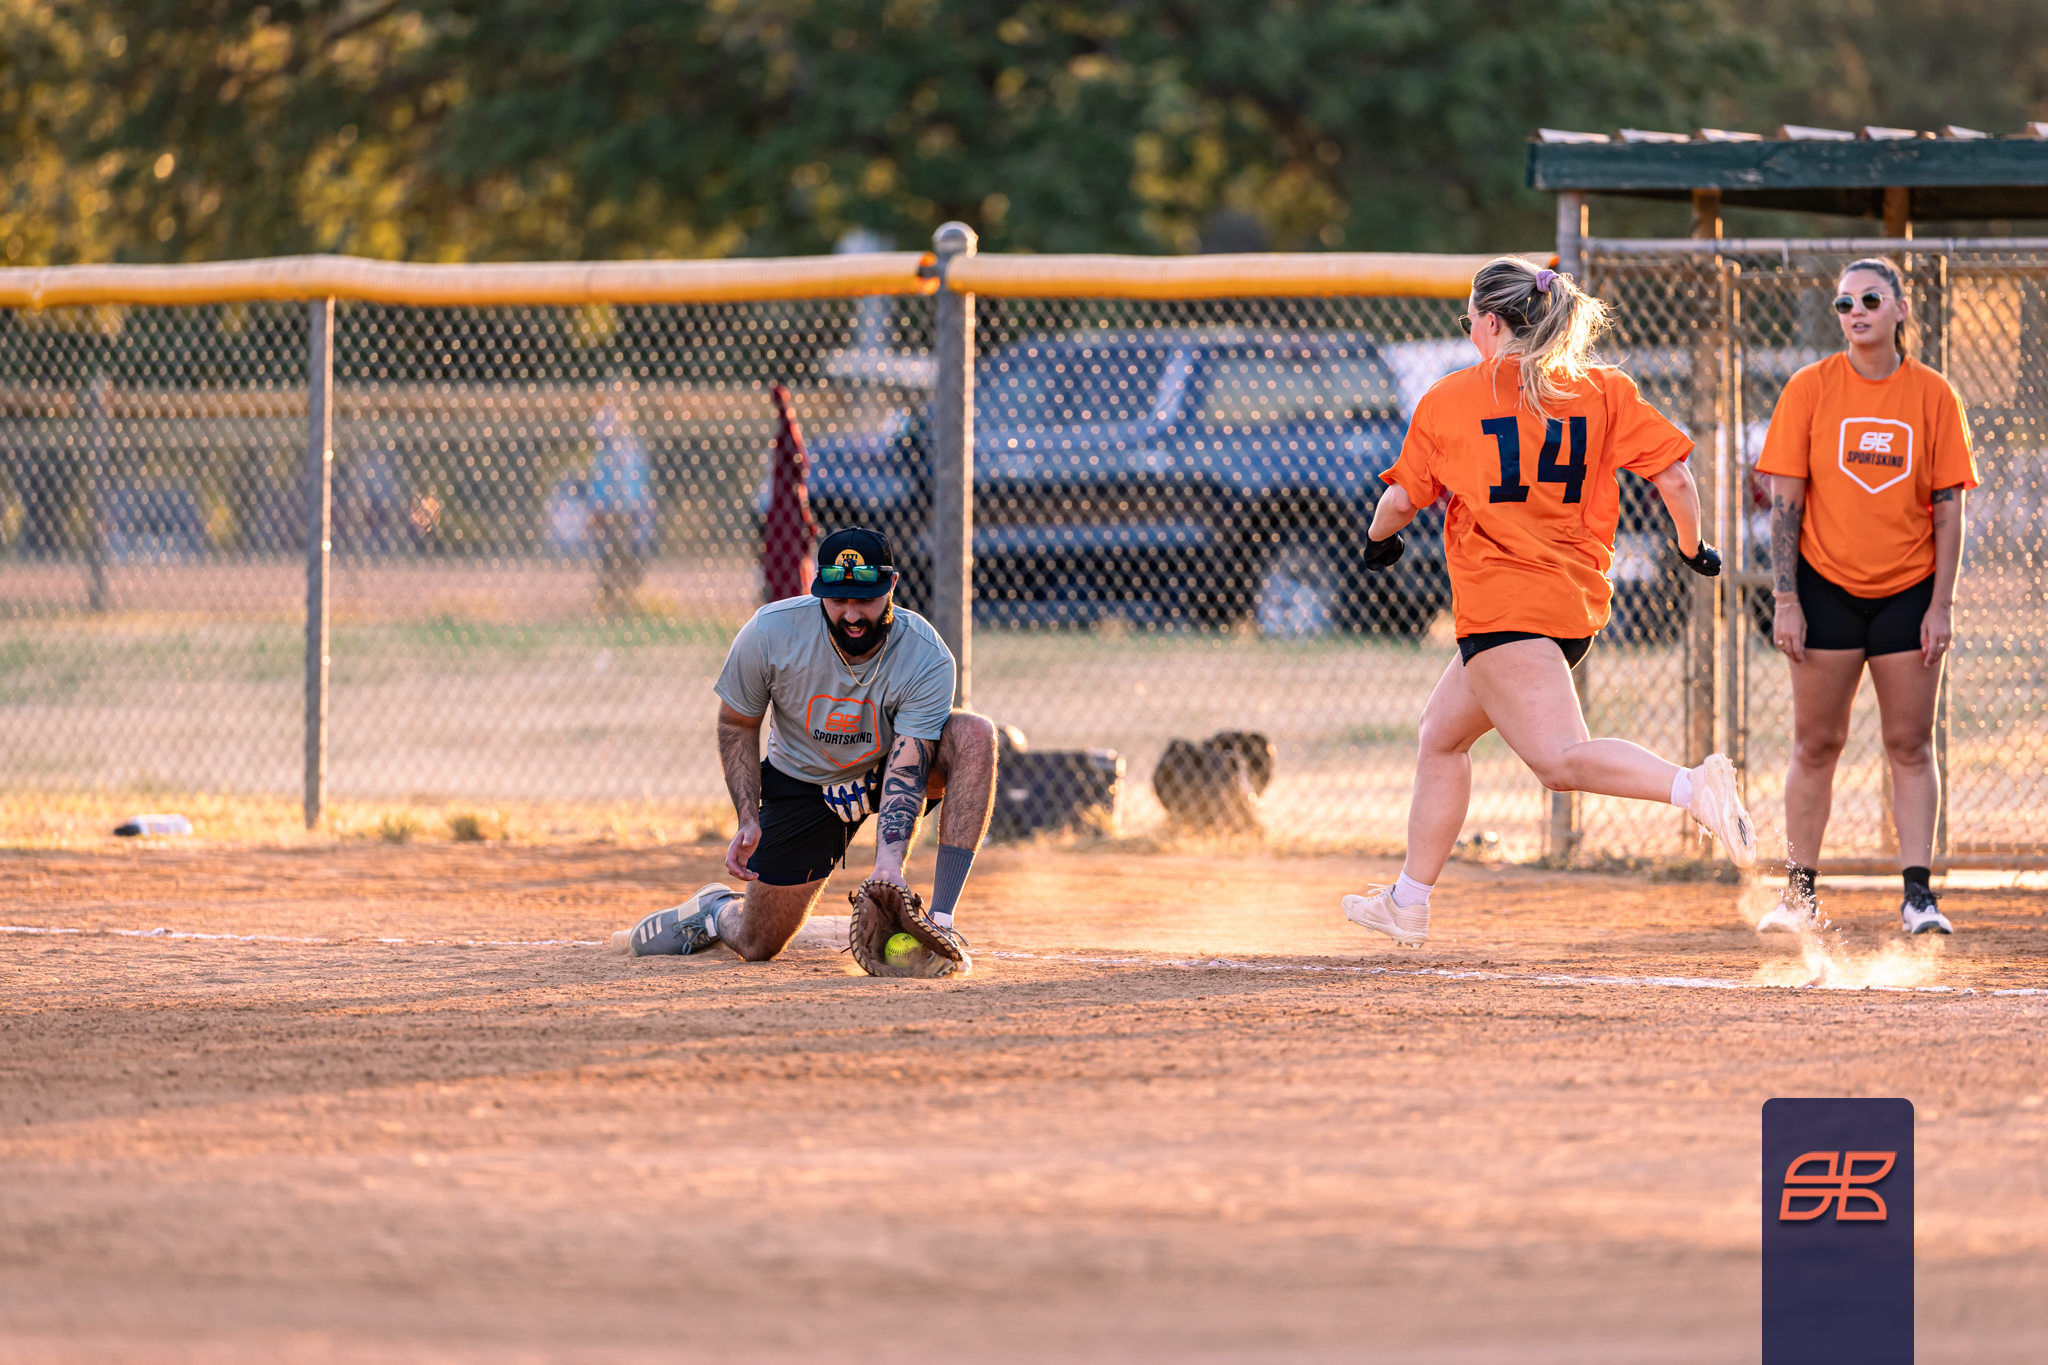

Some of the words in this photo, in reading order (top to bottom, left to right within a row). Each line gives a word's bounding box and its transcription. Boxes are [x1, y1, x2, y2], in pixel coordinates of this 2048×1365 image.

[1481, 416, 1587, 504] 14
[1846, 451, 1904, 468] SPORTSKIND
[813, 729, 872, 745] SPORTSKIND
